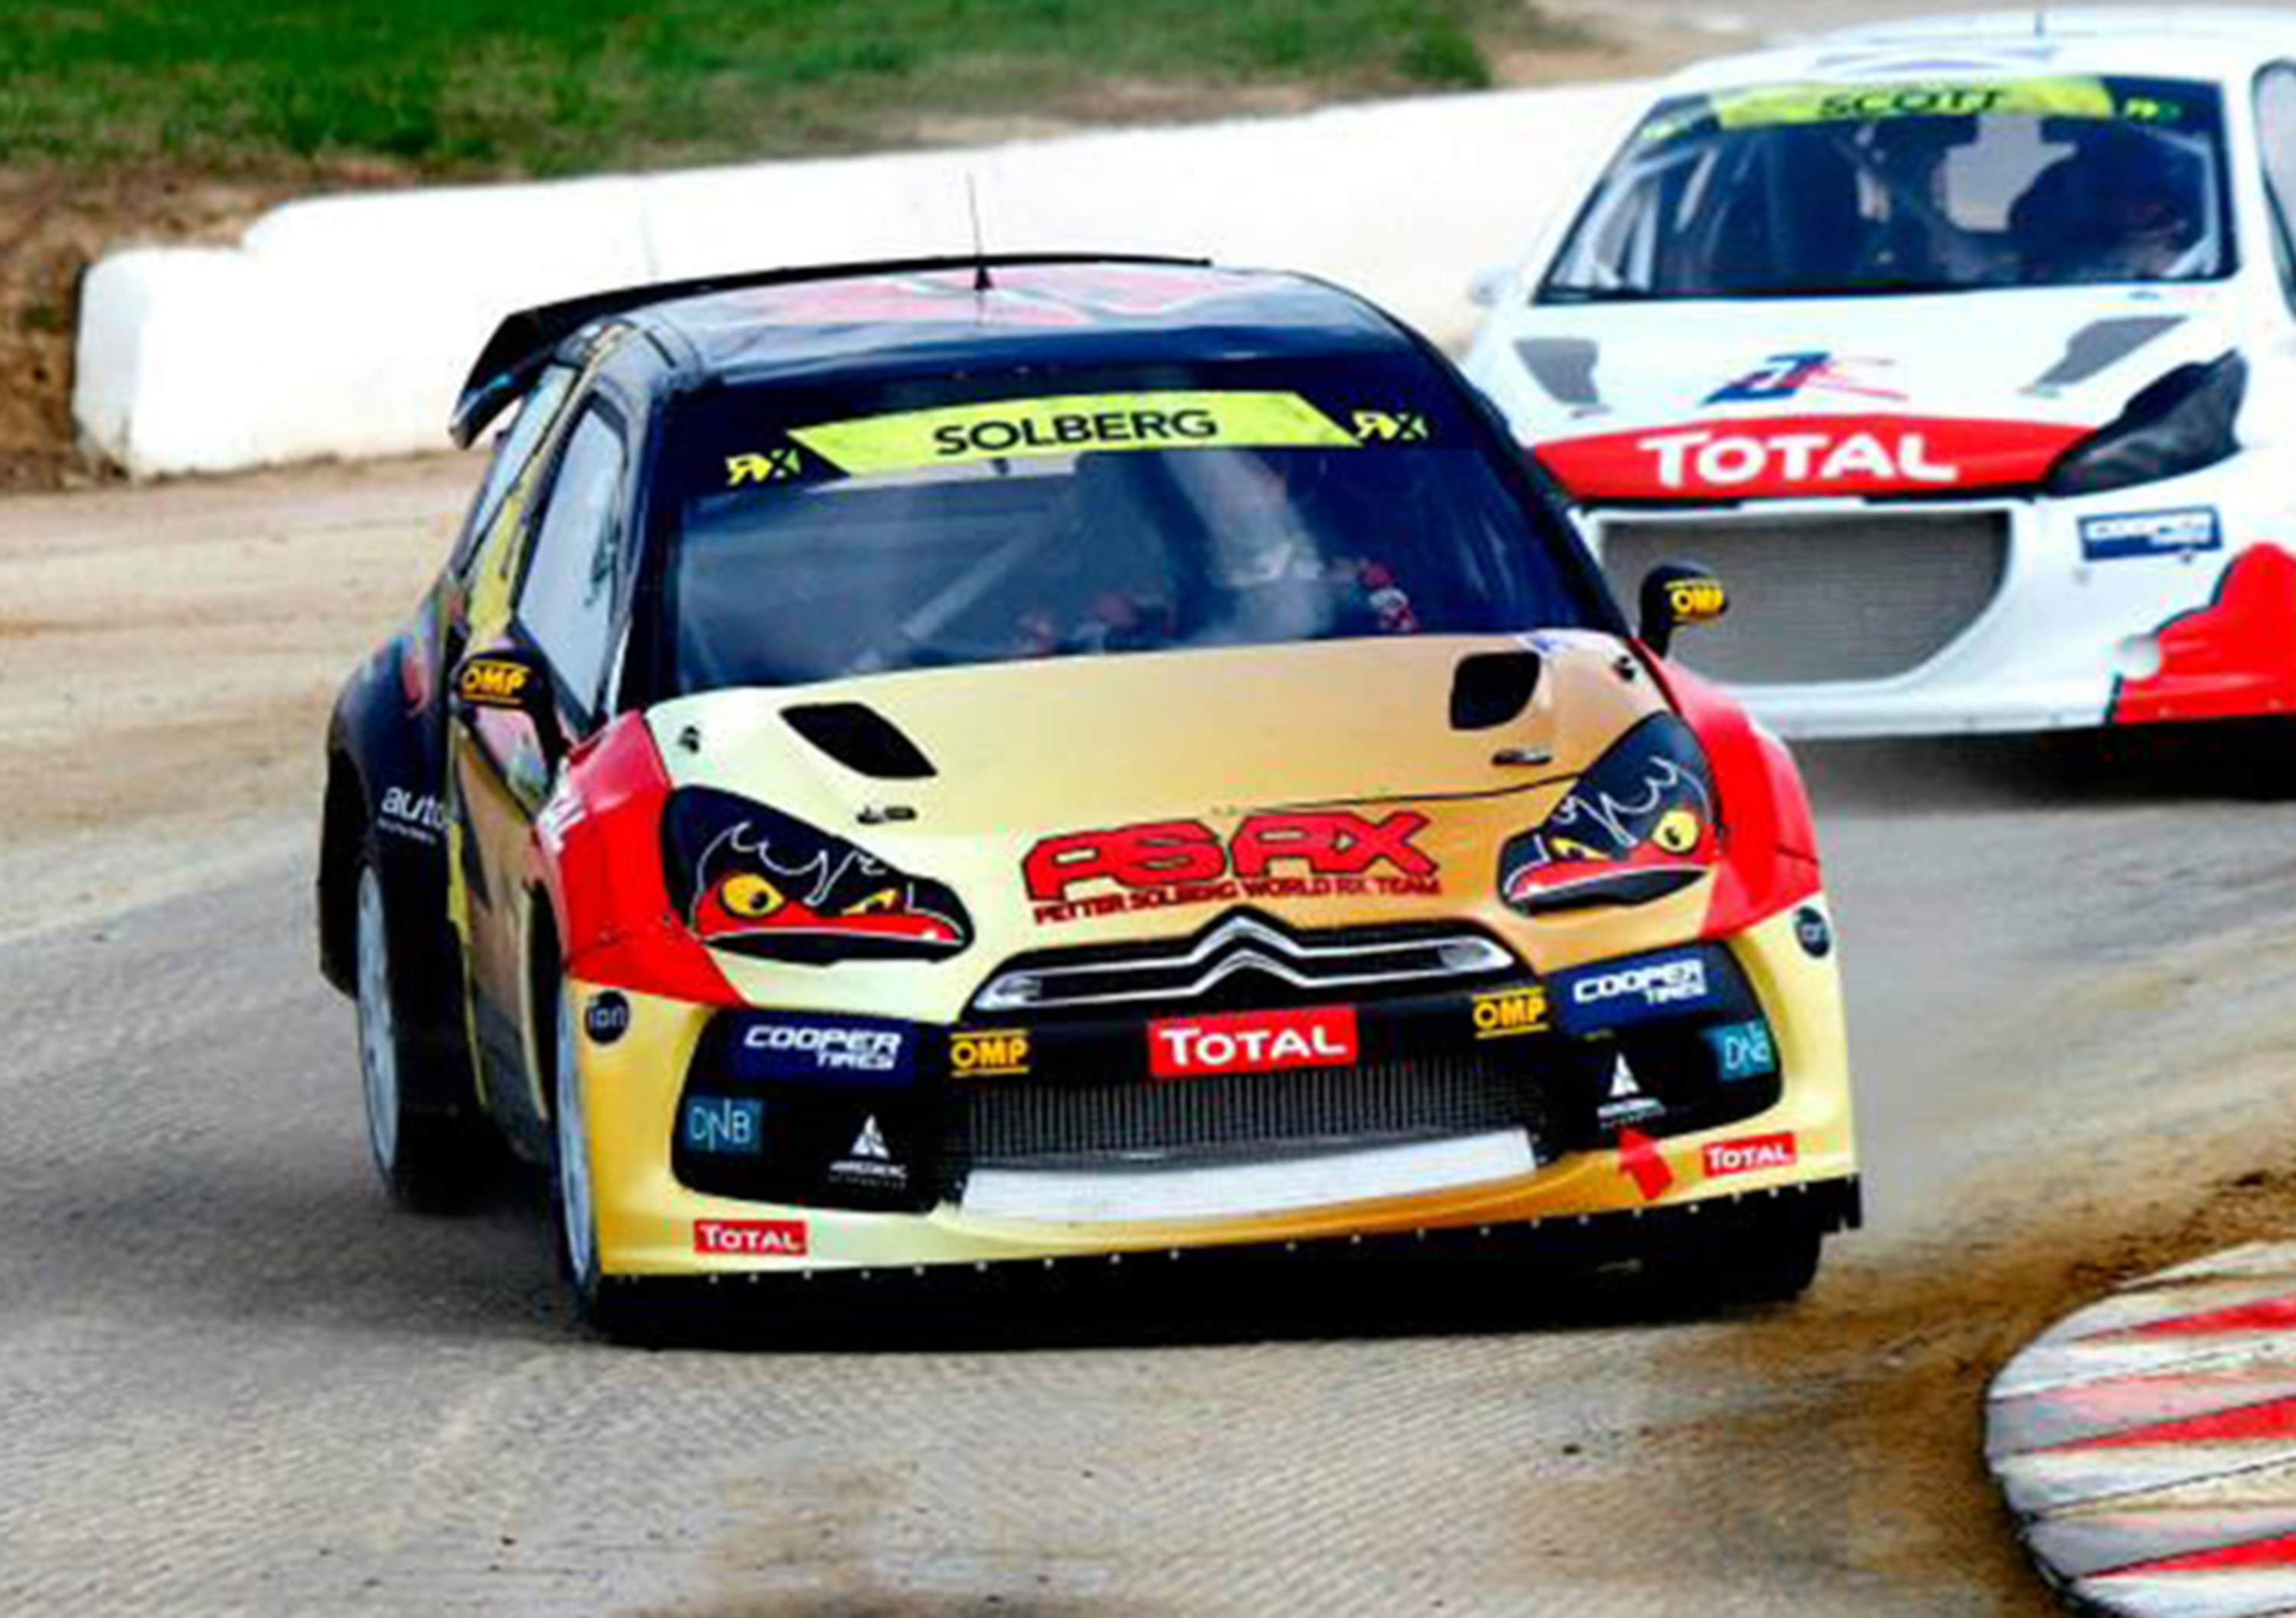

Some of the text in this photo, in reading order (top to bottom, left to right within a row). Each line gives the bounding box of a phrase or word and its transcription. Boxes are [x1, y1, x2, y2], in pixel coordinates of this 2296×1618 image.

[934, 408, 1218, 455] SOLBERG
[1639, 430, 1958, 487] TOTAL
[462, 665, 528, 695] OMP
[1034, 894, 1124, 924] PETTER
[1129, 880, 1238, 911] SOLBERG
[1240, 878, 1330, 899] WORLD
[1374, 876, 1443, 896] TEAM
[1574, 959, 1707, 1003] COOPER
[1473, 997, 1547, 1029] OMP
[744, 1026, 902, 1054] COOPER
[951, 1039, 1028, 1068] OMP
[1160, 1026, 1347, 1065] TOTAL
[815, 1050, 895, 1070] TIRES
[690, 1100, 752, 1151] DNB
[1707, 1144, 1788, 1168] TOTAL
[700, 1225, 801, 1251] TOTAL
